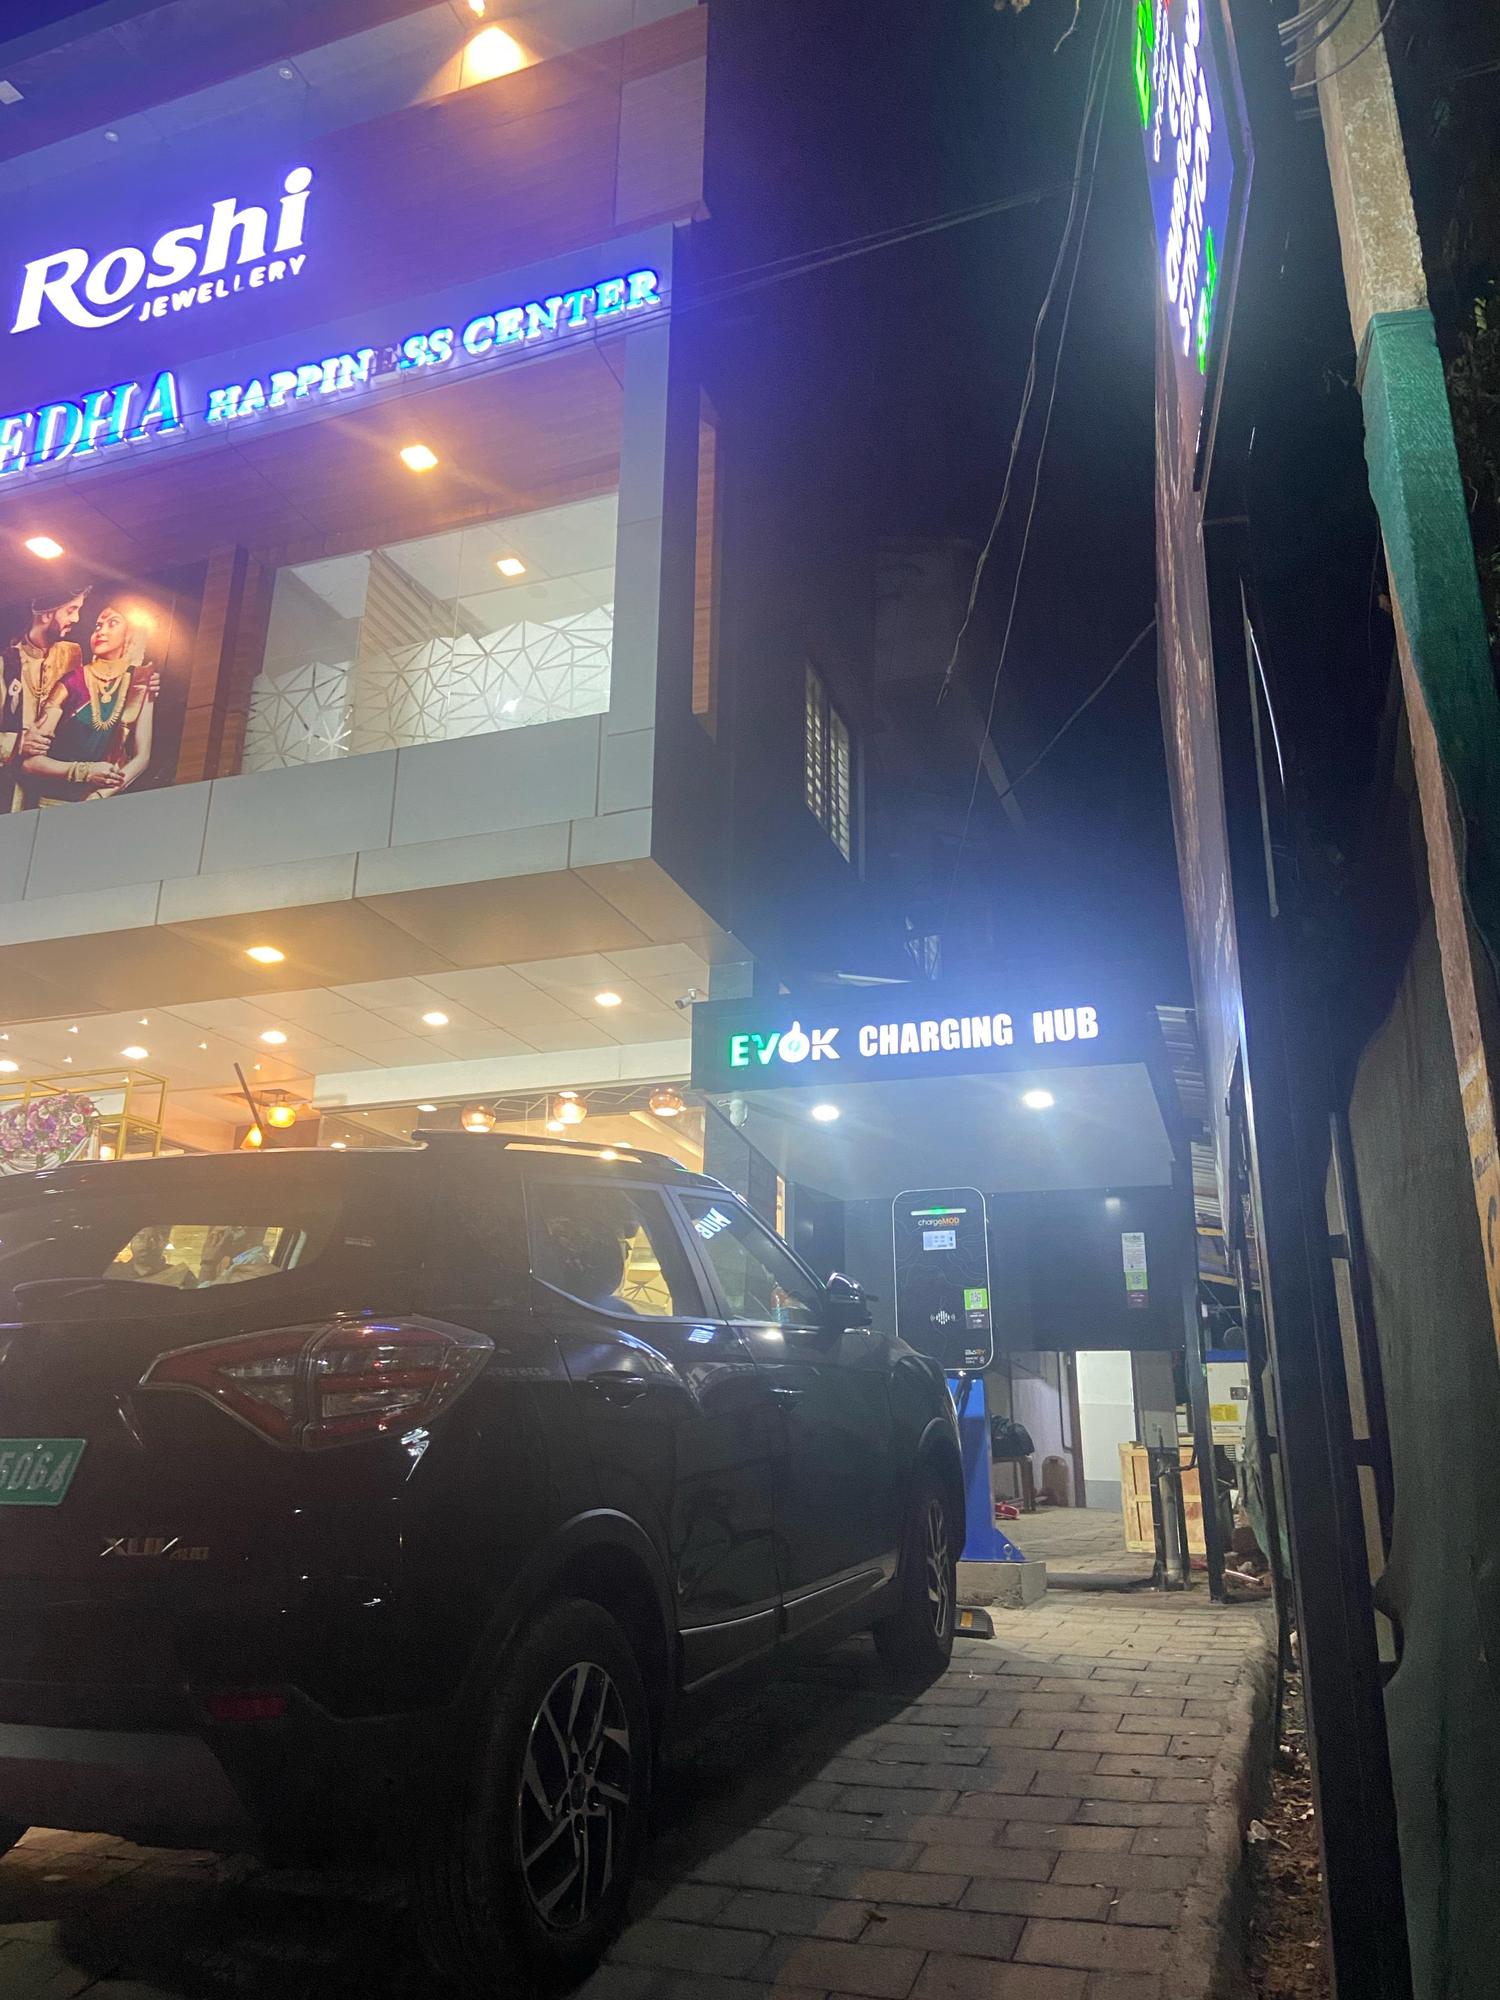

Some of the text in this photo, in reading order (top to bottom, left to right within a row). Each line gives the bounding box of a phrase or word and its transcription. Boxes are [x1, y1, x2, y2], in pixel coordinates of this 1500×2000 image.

[10, 166, 312, 334] Roshi
[138, 254, 306, 322] JEWELLERY
[1179, 65, 1211, 357] STATION
[203, 325, 454, 423] HAPPINESS
[462, 269, 661, 356] CENTER
[859, 1013, 1014, 1057] CHARGING
[1033, 1006, 1099, 1044] HUB
